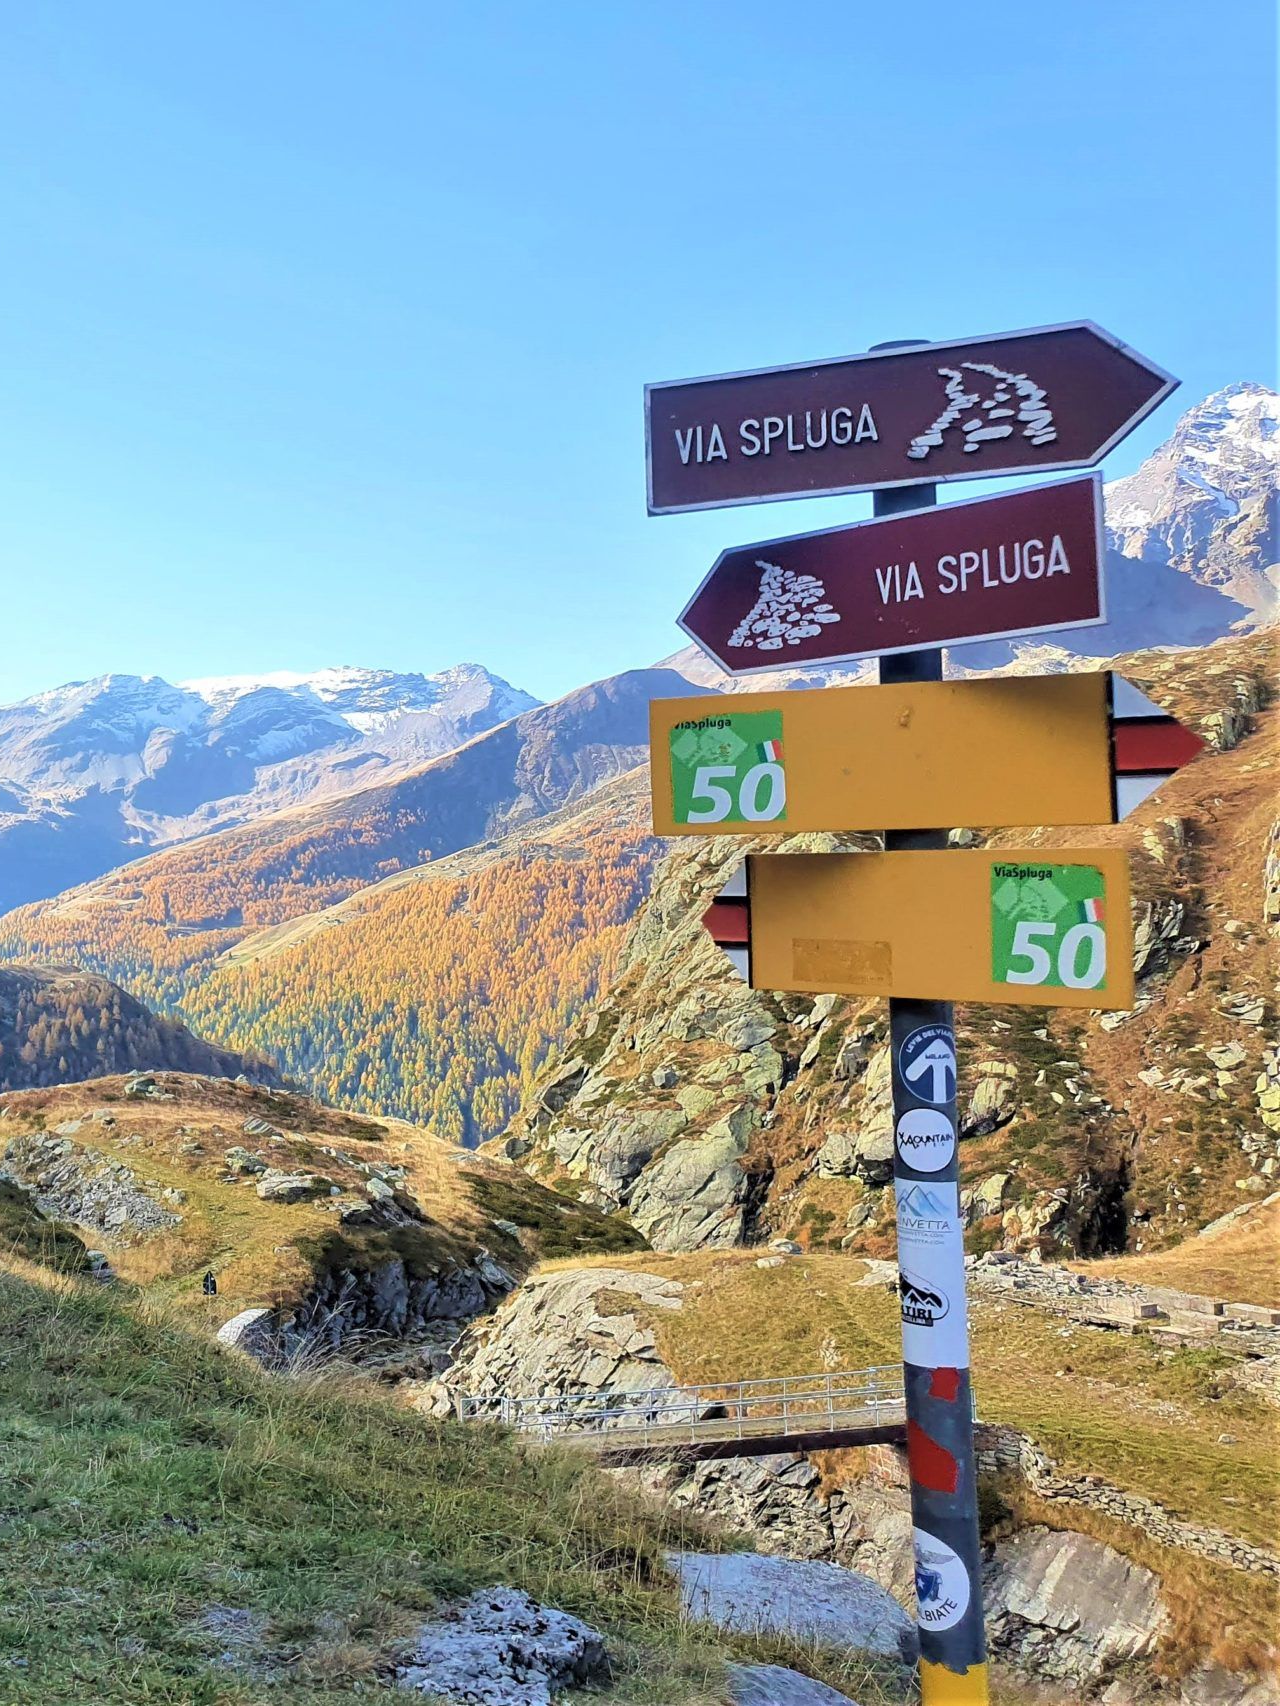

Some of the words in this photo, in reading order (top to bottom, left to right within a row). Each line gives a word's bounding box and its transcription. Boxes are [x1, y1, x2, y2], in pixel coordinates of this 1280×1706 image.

[674, 422, 728, 465] VIA
[739, 403, 879, 457] SPLUGA
[875, 560, 925, 605] VIA
[937, 535, 1071, 595] SPLUGA
[687, 762, 787, 824] 50
[993, 866, 1053, 881] ViaSpluga
[1006, 921, 1107, 989] 50
